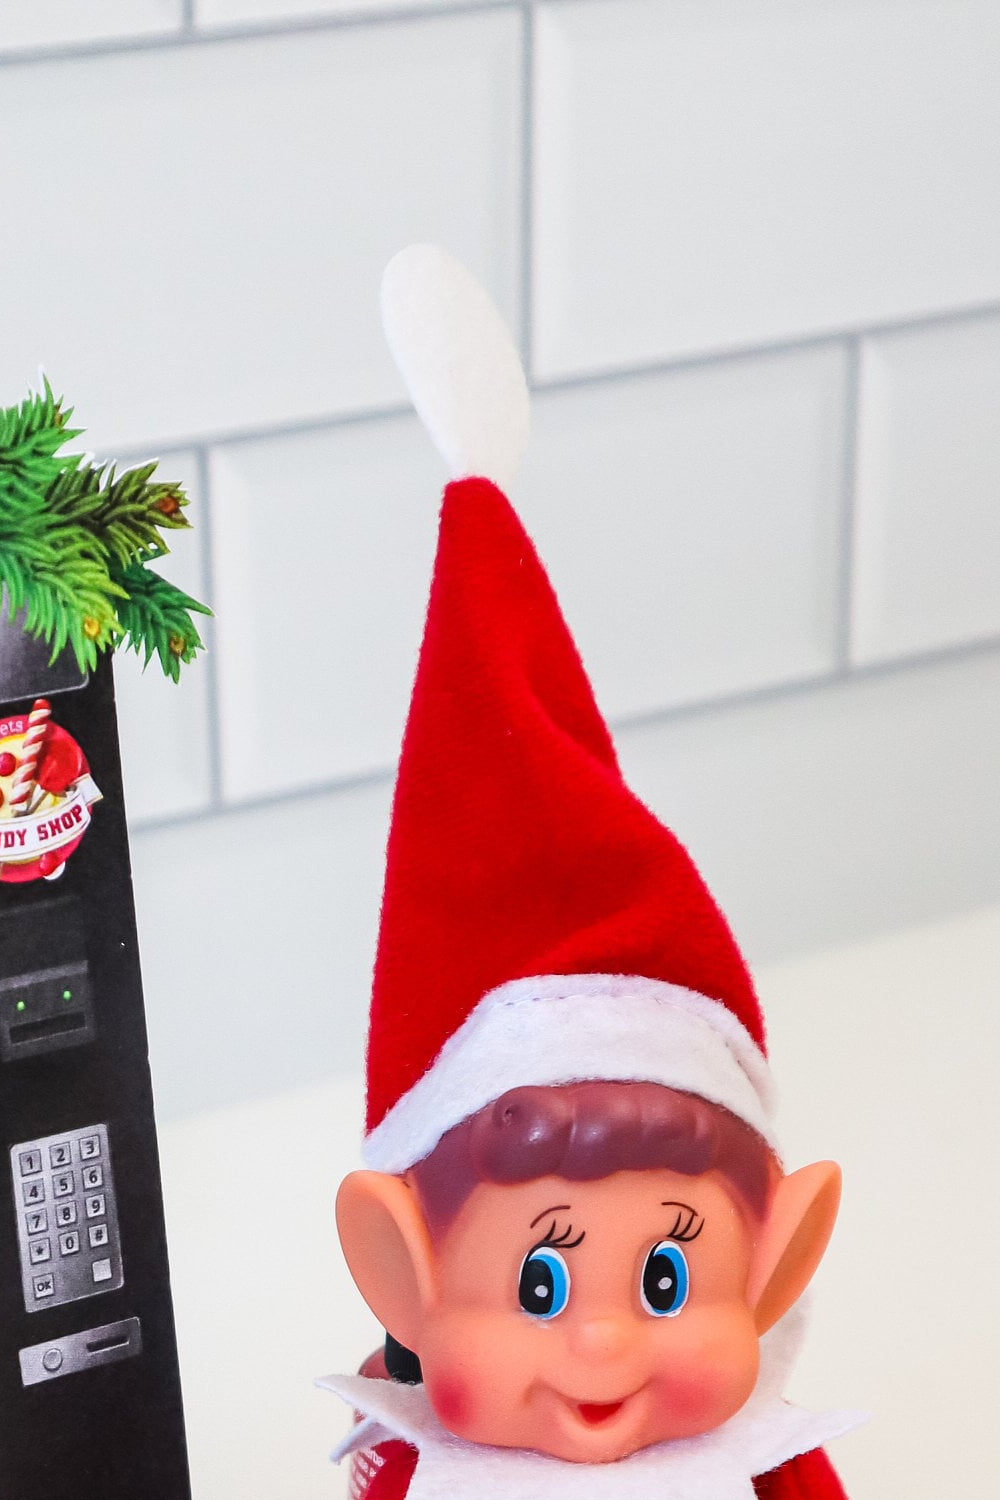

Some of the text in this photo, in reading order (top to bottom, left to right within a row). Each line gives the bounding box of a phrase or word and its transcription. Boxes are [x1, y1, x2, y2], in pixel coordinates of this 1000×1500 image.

[36, 804, 83, 841] SHOP
[26, 1140, 95, 1170] 1 2 3
[29, 1169, 98, 1199] 4 5 6
[31, 1199, 100, 1229] 7 8 9
[65, 1236, 75, 1250] 0
[36, 1280, 52, 1292] OK
